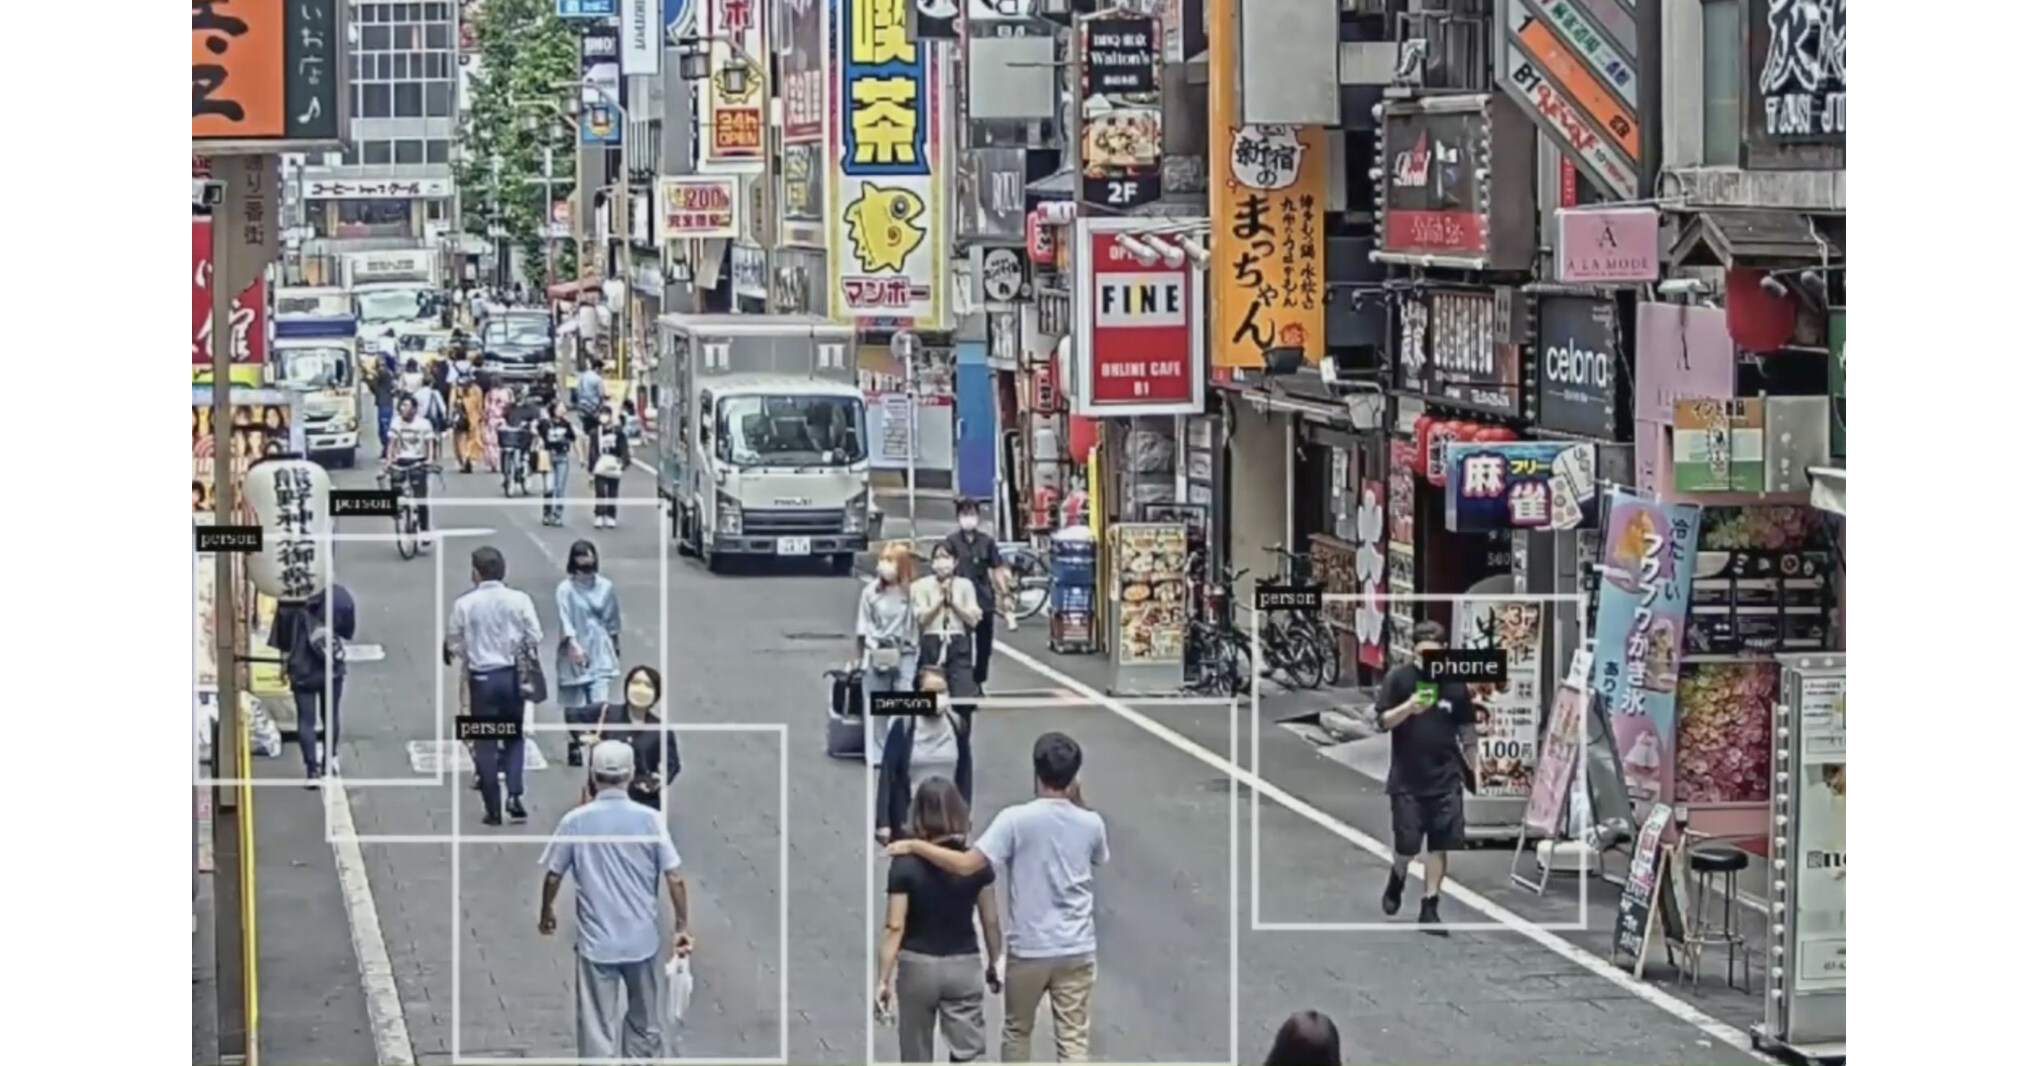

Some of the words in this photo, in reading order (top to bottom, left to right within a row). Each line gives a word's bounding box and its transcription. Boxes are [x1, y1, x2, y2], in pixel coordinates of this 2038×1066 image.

[1234, 138, 1296, 171] 新宿
[1107, 182, 1139, 203] 2F
[1232, 194, 1278, 350] まっちゃん
[1102, 285, 1179, 315] FINE
[1101, 362, 1147, 377] ONLINE
[1150, 361, 1181, 377] CAFE
[1510, 459, 1551, 475] フリー
